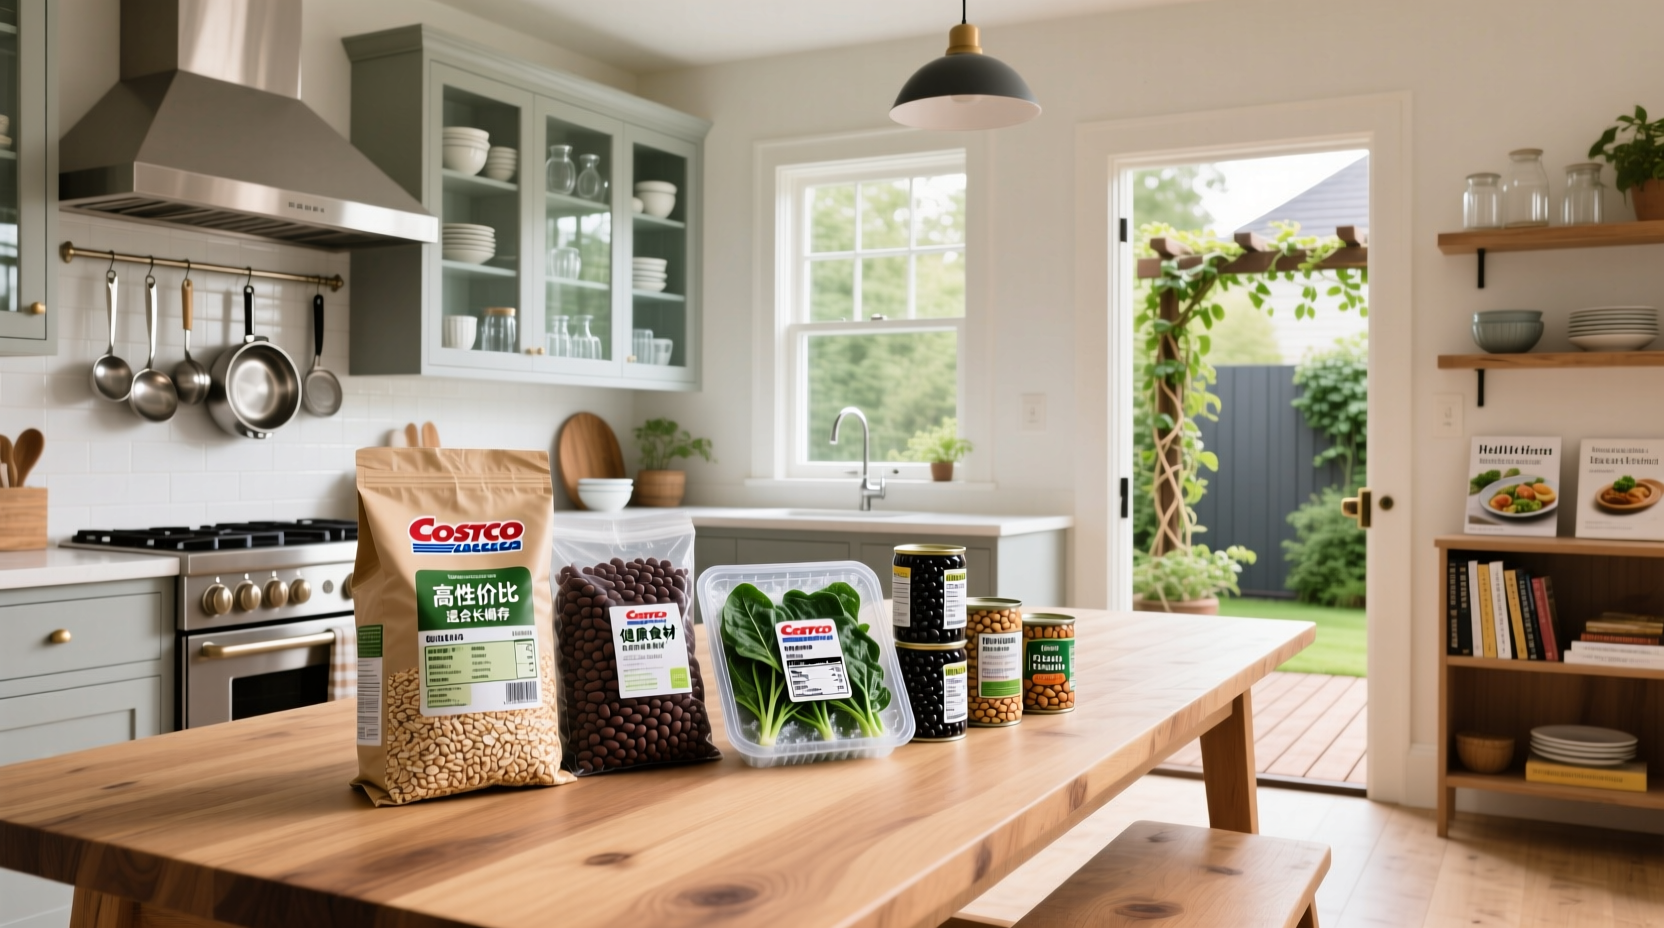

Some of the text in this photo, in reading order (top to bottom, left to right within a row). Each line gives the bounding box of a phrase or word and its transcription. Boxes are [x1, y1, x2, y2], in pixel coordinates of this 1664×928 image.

[409, 518, 524, 542] COSTCO
[432, 581, 519, 608] 高性价比
